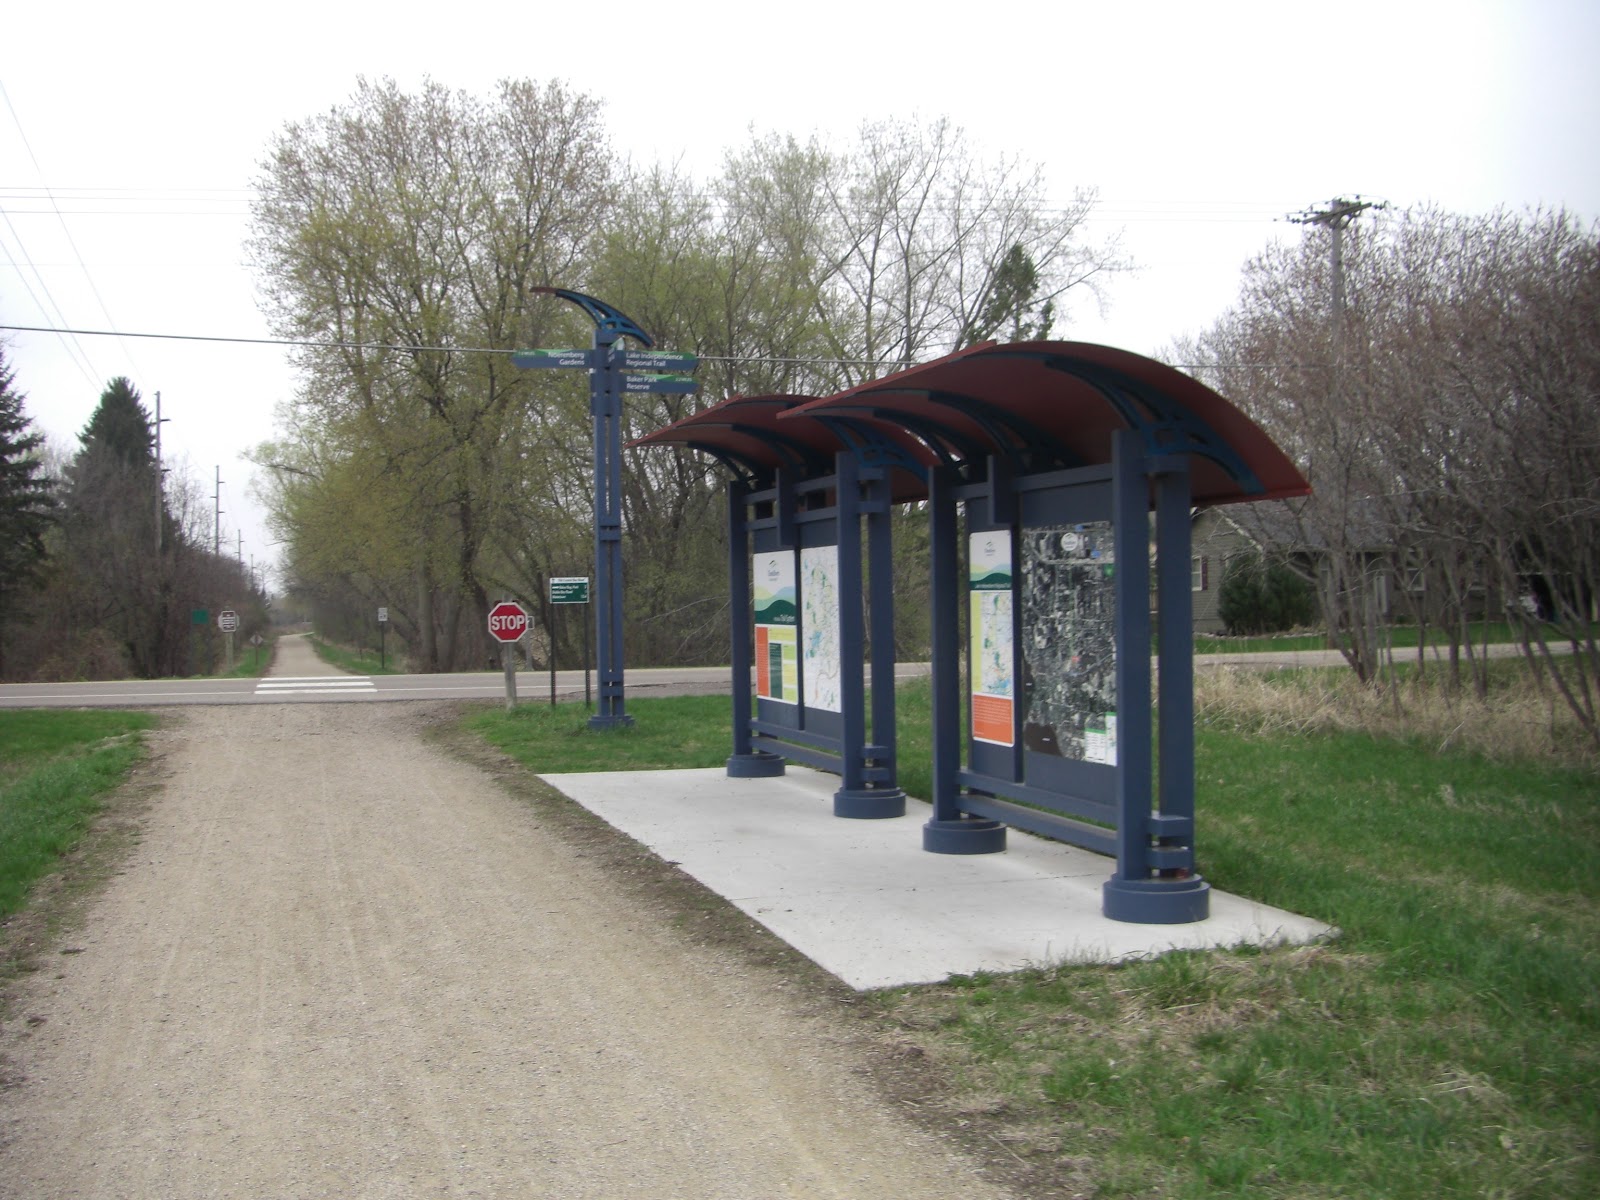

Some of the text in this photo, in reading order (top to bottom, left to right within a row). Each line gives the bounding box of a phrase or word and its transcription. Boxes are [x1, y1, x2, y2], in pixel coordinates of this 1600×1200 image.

[626, 359, 652, 368] Regional
[626, 375, 643, 383] Baker
[491, 615, 525, 630] STOP
